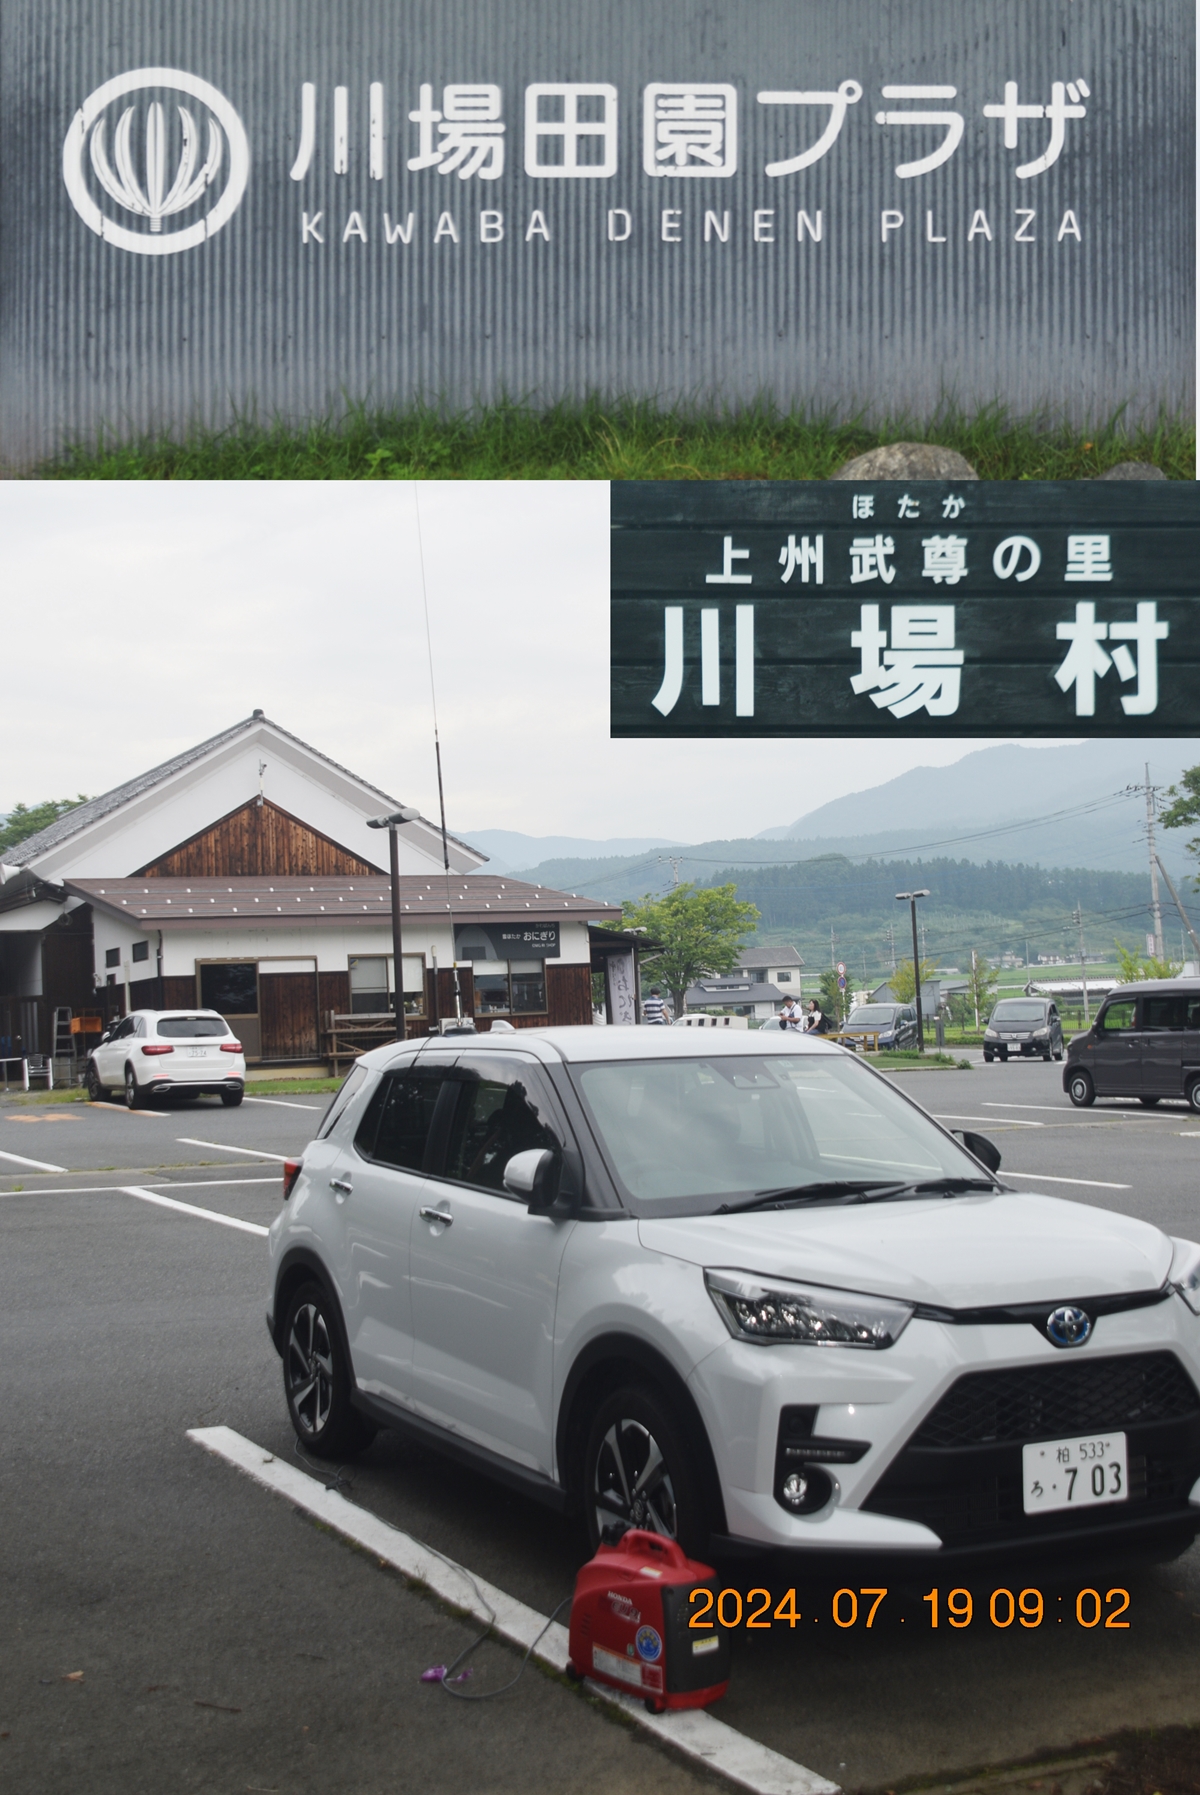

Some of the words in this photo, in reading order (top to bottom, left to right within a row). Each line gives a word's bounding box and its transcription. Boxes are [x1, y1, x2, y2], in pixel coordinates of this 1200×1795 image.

[290, 79, 1090, 180] 川場田園プラザ
[301, 211, 550, 243] KAWABA
[608, 210, 822, 242] DENEN
[881, 210, 1081, 242] PLAZA
[853, 494, 966, 518] ほたか
[706, 535, 1112, 584] 上州武尊の里
[652, 602, 1168, 718] 川場村
[523, 931, 556, 941] おにぎり
[1056, 1446, 1070, 1463] 柏
[1079, 1441, 1105, 1460] 533
[1030, 1480, 1044, 1498] ろ
[607, 1590, 633, 1606] HONDA
